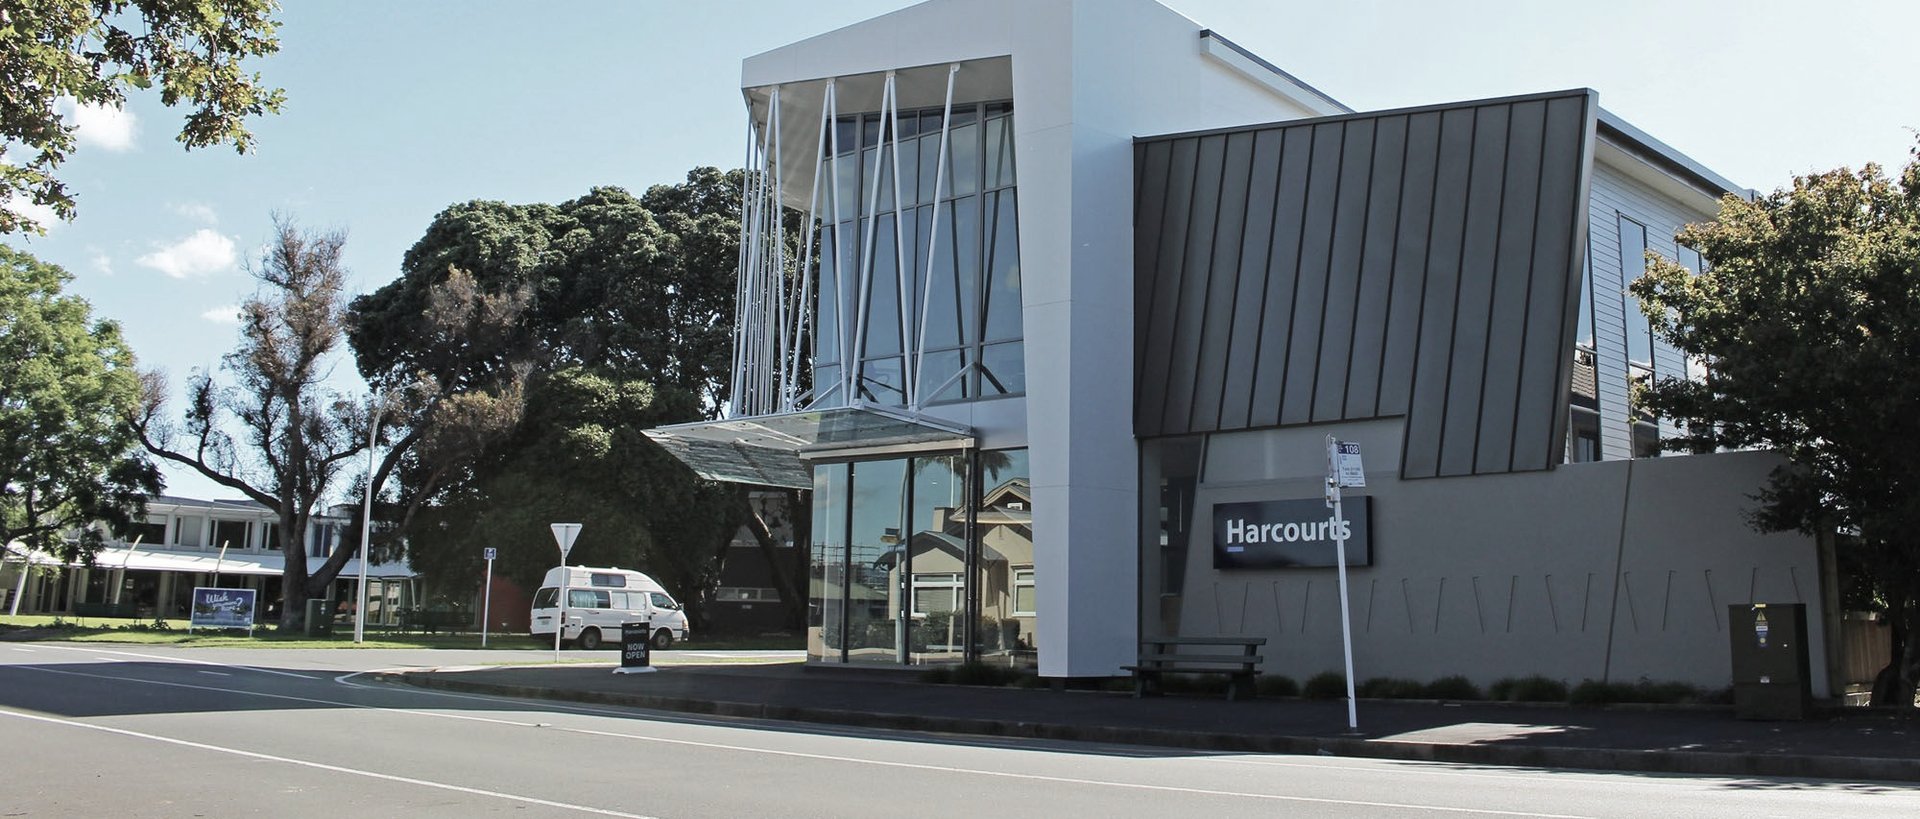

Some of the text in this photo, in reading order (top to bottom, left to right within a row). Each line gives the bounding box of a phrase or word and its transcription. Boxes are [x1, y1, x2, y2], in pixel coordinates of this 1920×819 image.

[1226, 516, 1352, 544] Harcourts
[627, 643, 645, 651] NOW
[626, 650, 645, 659] OPEN
